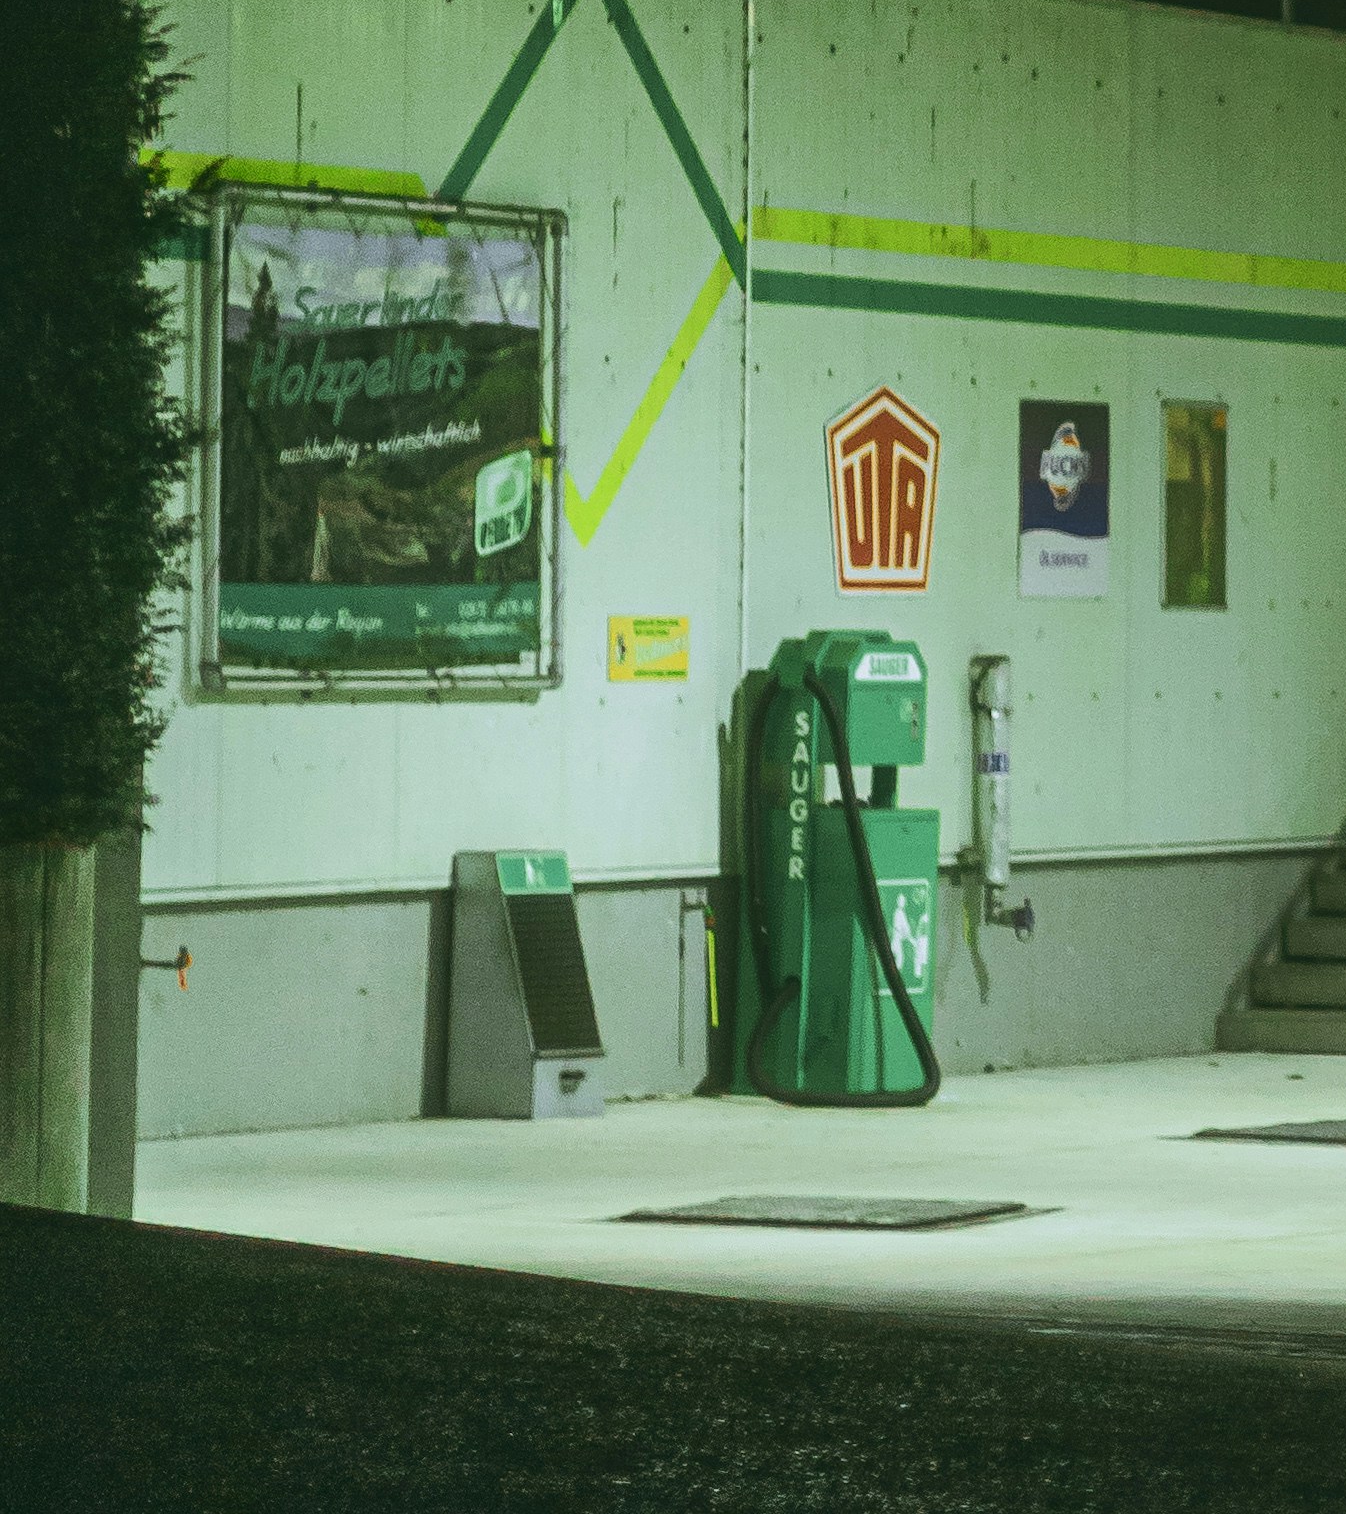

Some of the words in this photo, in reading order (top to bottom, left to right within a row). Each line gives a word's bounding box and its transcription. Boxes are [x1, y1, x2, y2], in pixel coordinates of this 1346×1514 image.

[246, 327, 468, 427] Holzpellets
[278, 433, 360, 468] nachhaltig
[376, 418, 482, 455] wirtschaftlich
[840, 408, 930, 570] UTA
[868, 654, 909, 676] SAUGER
[788, 710, 810, 880] SAUGER
